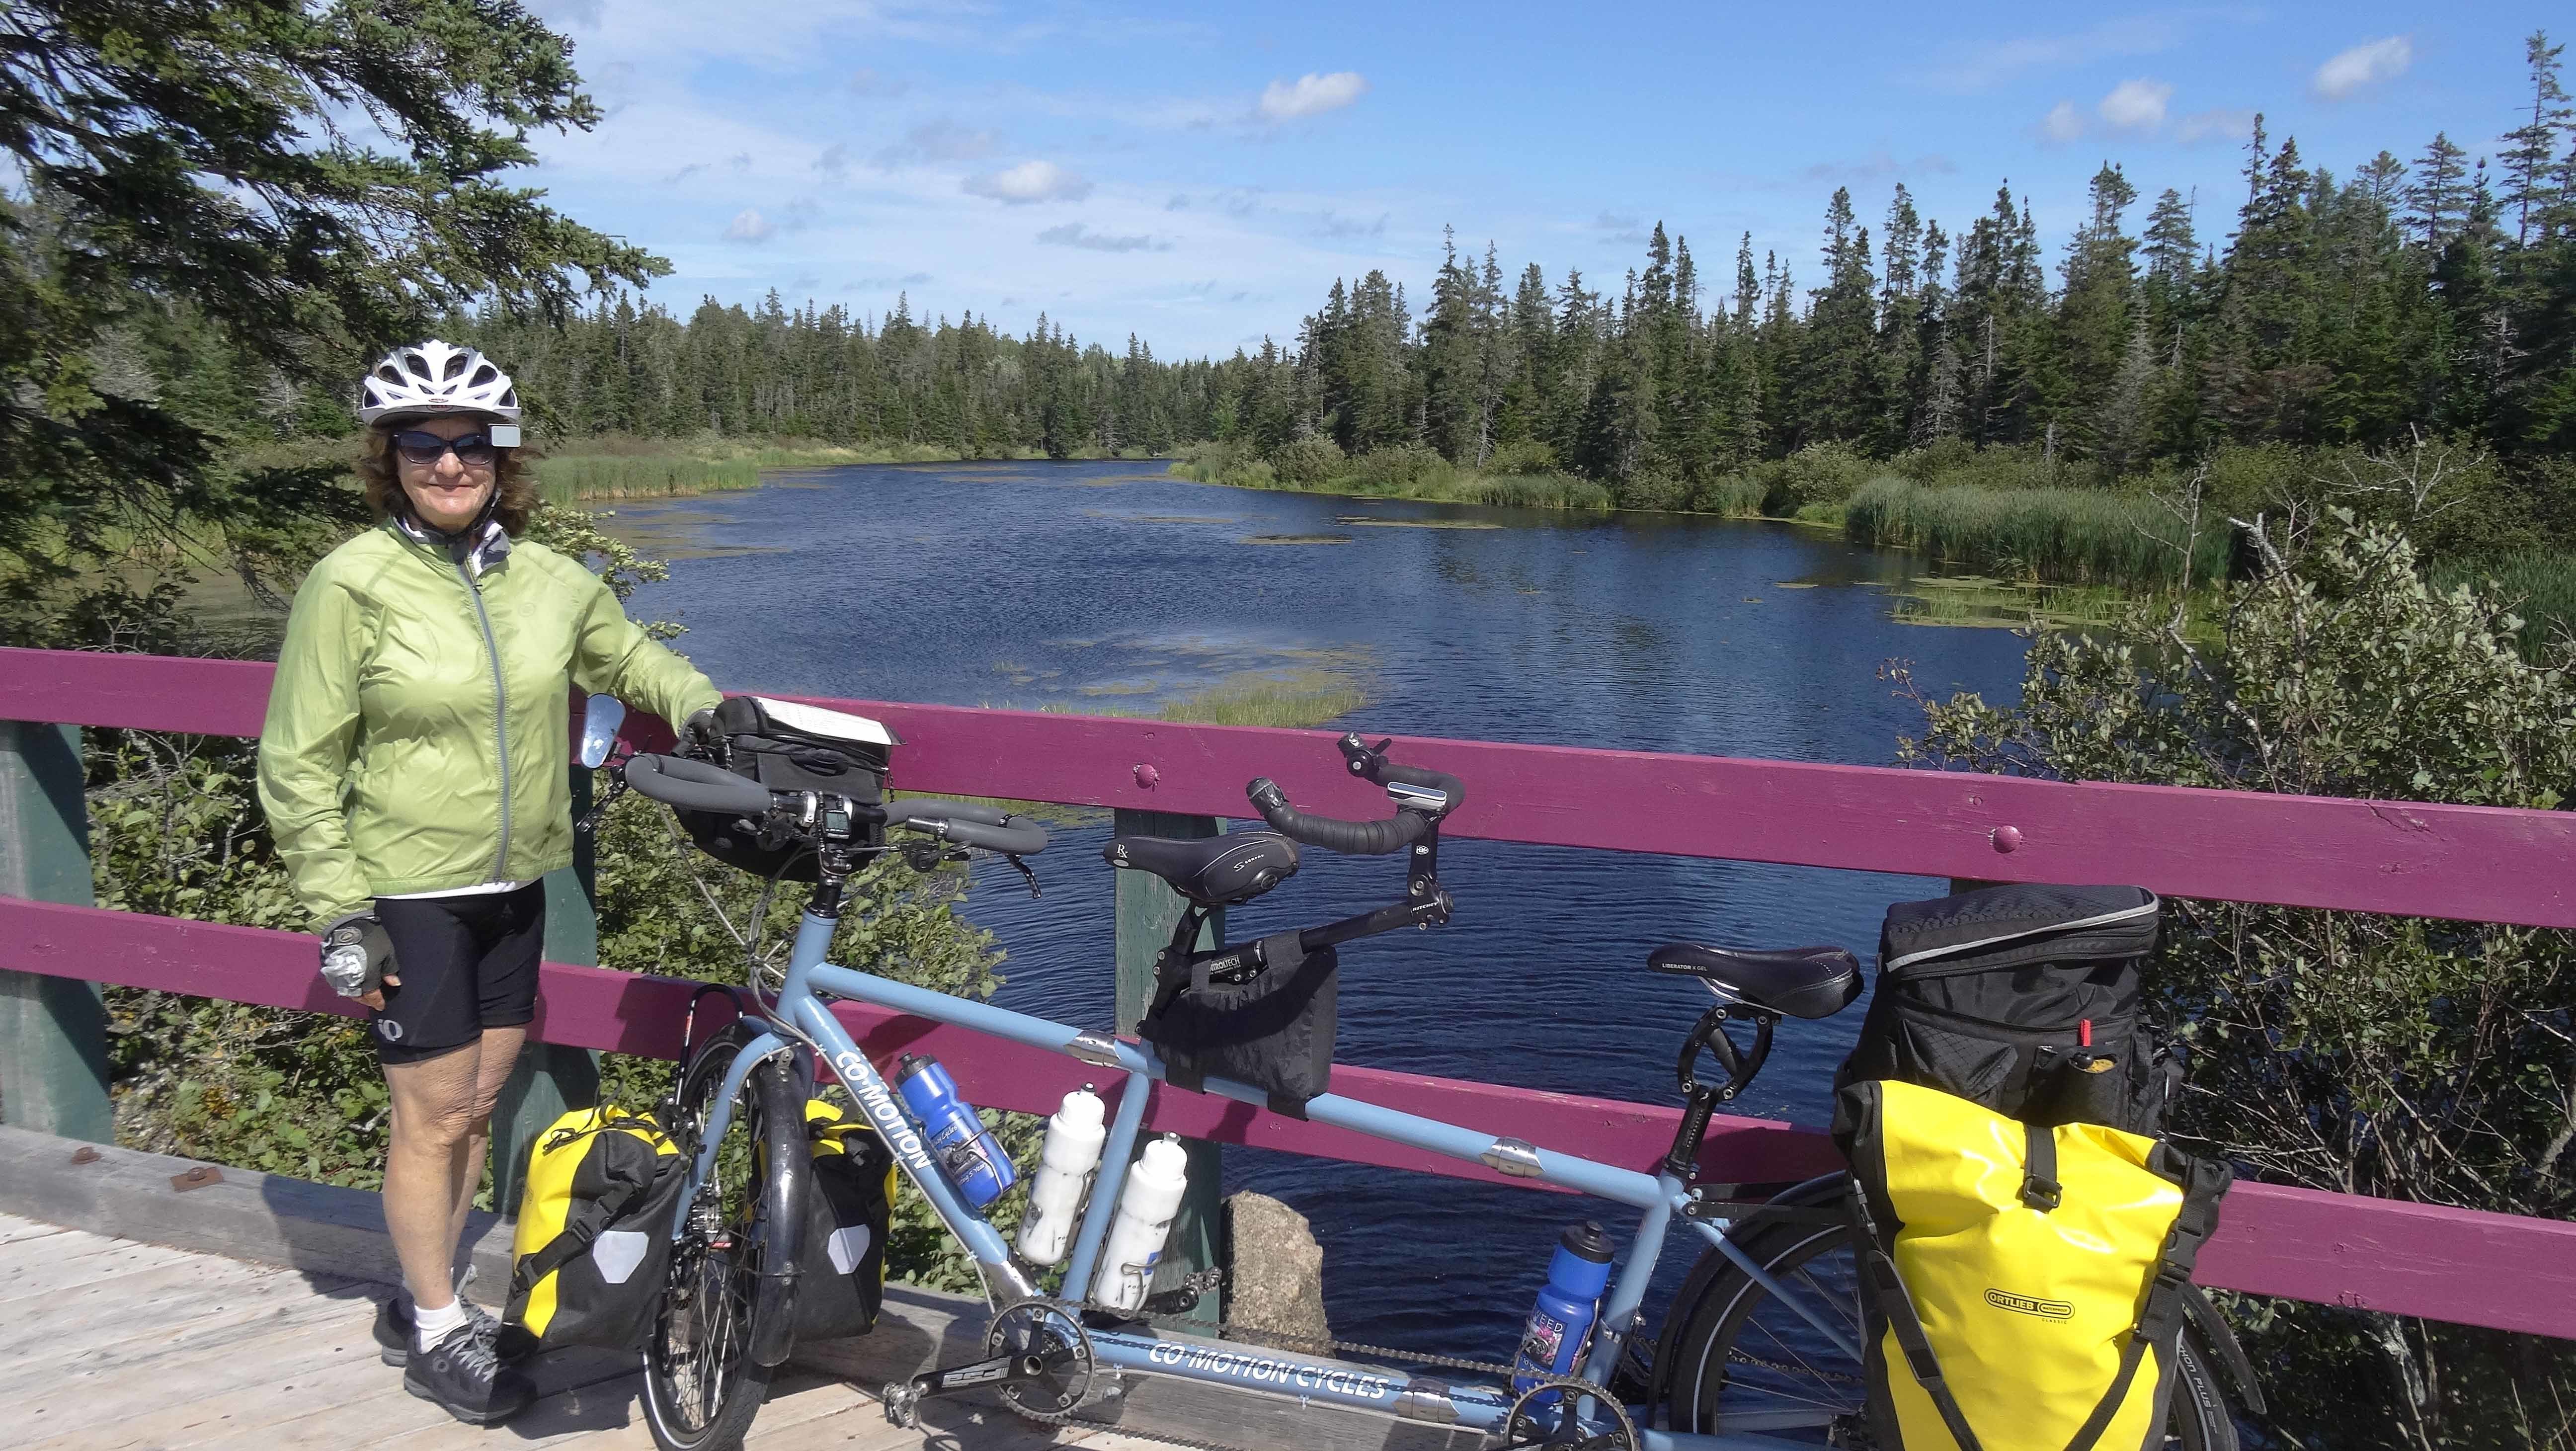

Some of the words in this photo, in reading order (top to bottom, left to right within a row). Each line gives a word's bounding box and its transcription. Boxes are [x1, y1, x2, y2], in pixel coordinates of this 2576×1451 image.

[1412, 901, 1439, 911] RITCHEY
[1989, 1293, 2034, 1310] ORTLIEB
[1295, 1365, 1390, 1400] CYCLES
[2178, 1343, 2196, 1373] THON
[2194, 1377, 2211, 1408] PLUS
